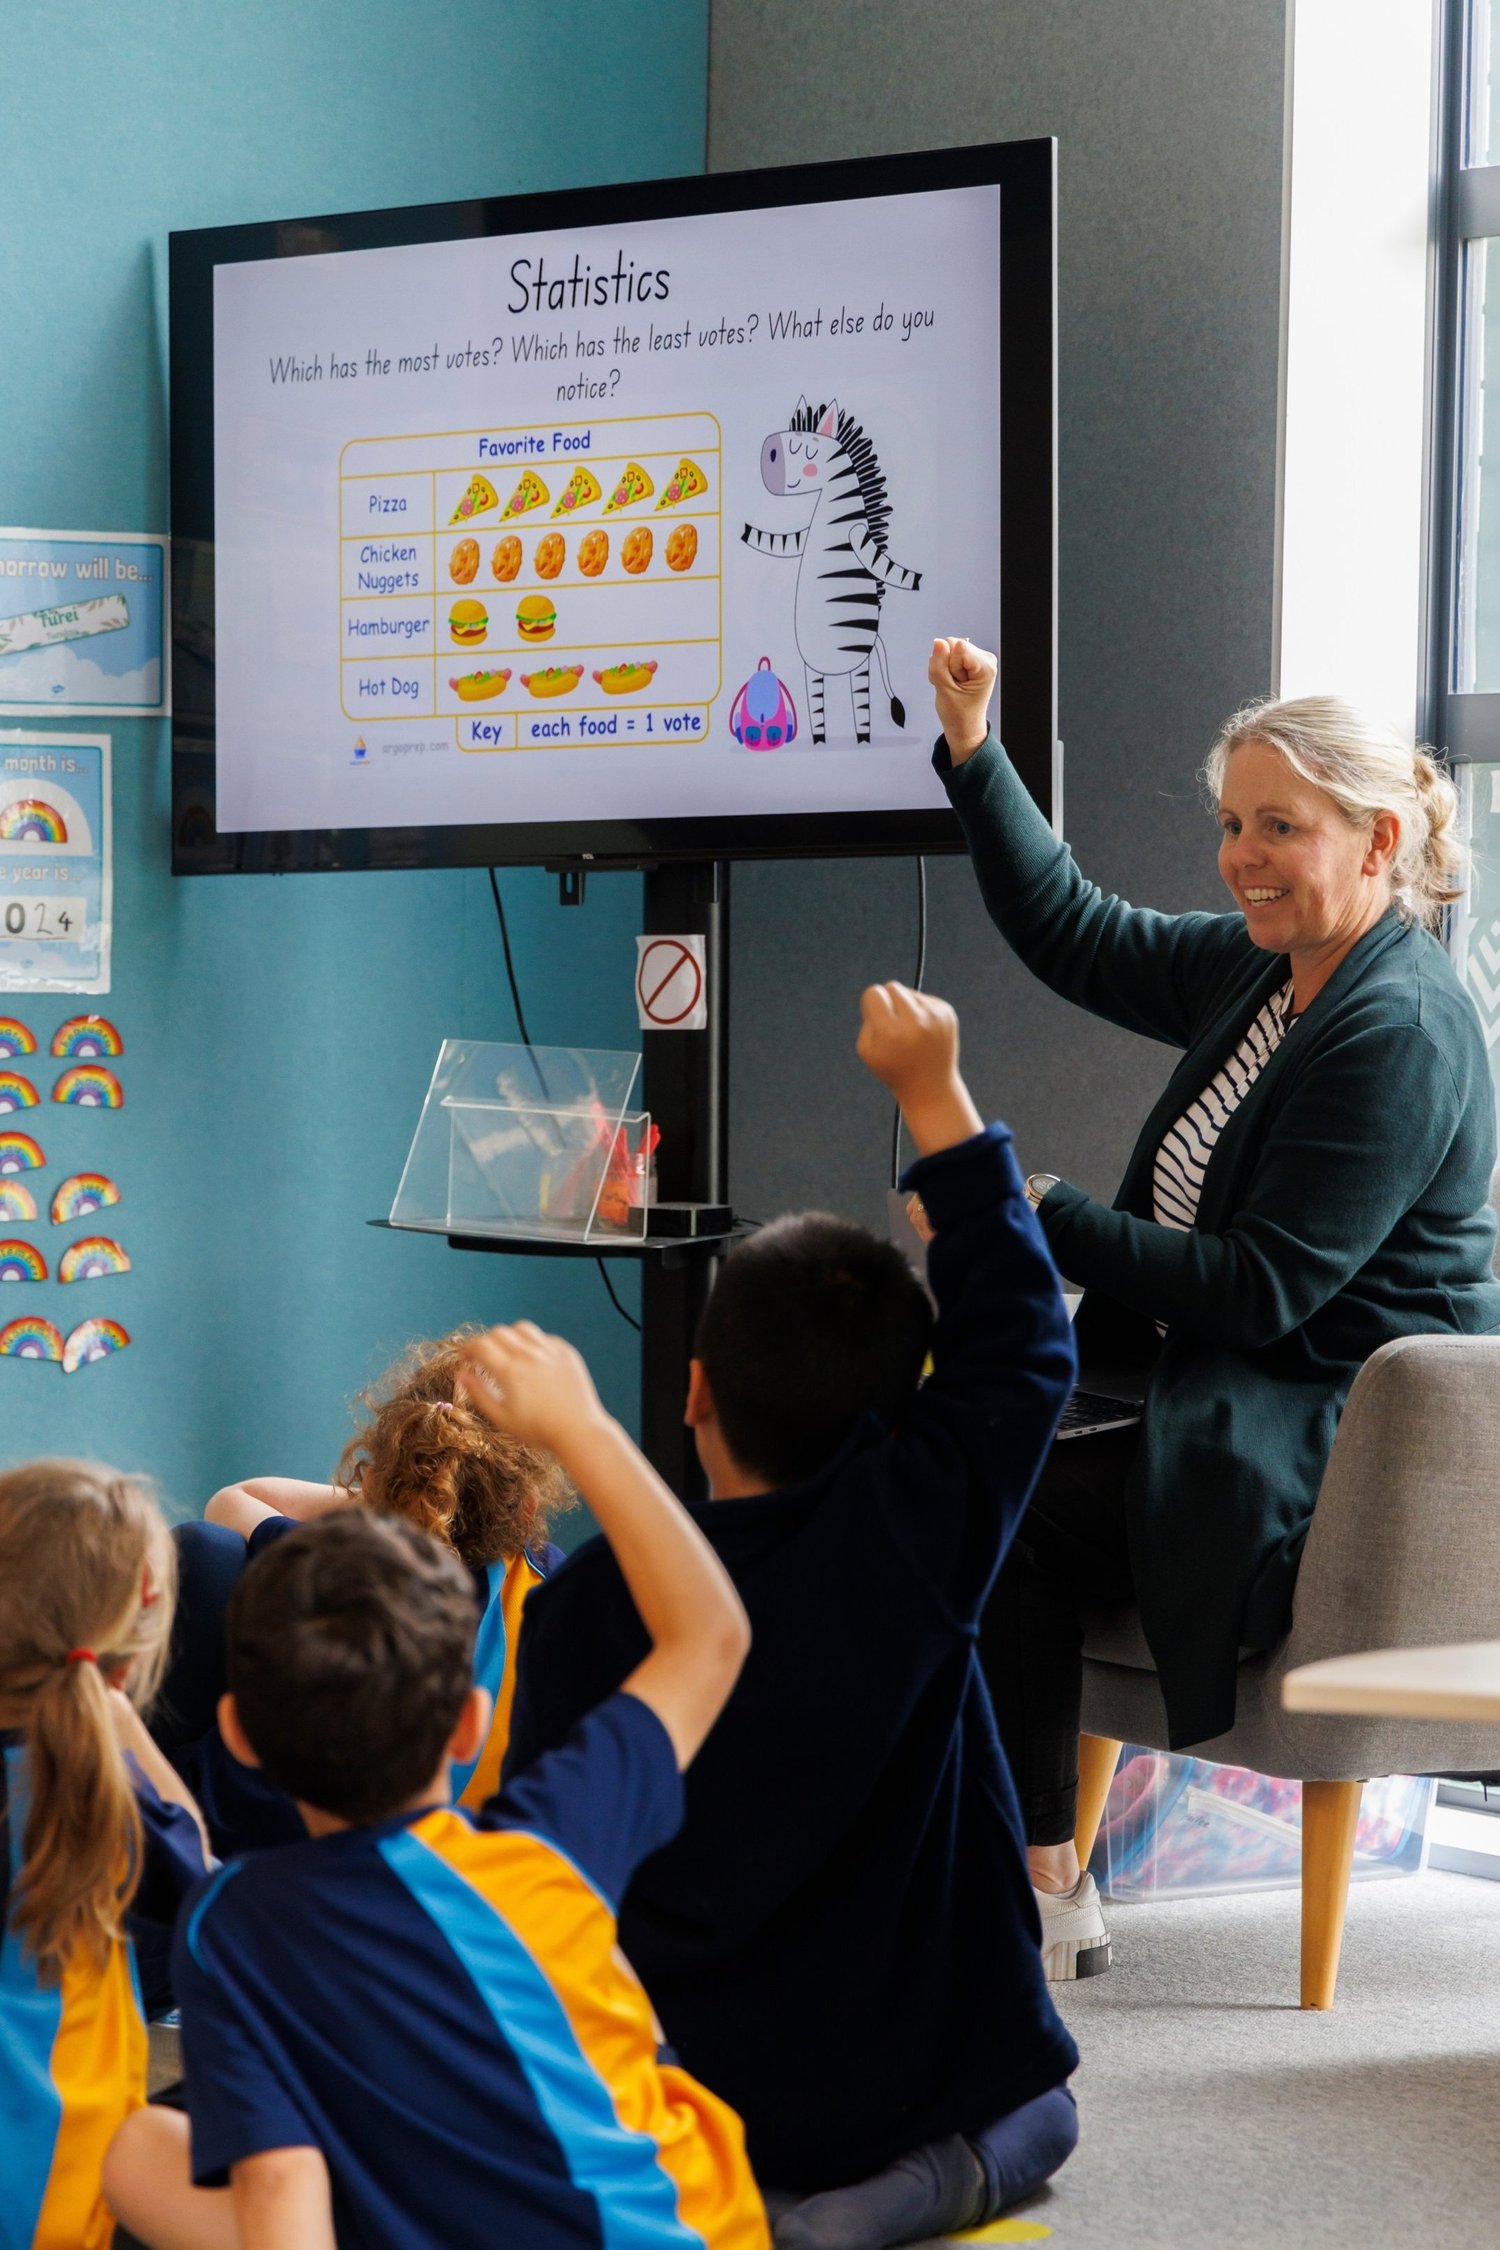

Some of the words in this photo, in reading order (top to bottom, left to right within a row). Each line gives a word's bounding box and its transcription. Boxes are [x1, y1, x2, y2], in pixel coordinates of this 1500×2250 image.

[507, 249, 671, 314] Statistics
[269, 354, 323, 384] Which
[330, 352, 358, 379] has
[364, 349, 391, 376] the
[398, 343, 440, 374] most
[446, 337, 503, 368] votes?
[511, 331, 568, 363] Which
[576, 330, 605, 357] has
[613, 326, 640, 354] the
[649, 320, 692, 352] least
[698, 313, 759, 346] votes?
[768, 308, 823, 341] What
[830, 306, 864, 335] else
[872, 302, 894, 332] do
[902, 309, 935, 342] you
[556, 368, 621, 402] notice?
[479, 436, 545, 458] Favorite
[552, 430, 591, 453] Food
[368, 495, 408, 513] Pizza
[360, 545, 417, 564] Chicken
[75, 557, 109, 579] will
[358, 571, 419, 595] Nuggets
[348, 616, 429, 637] Hamburger
[359, 678, 387, 697] Hot
[391, 677, 419, 699] Dog
[471, 720, 502, 744] Key
[531, 716, 571, 737] each
[579, 714, 618, 736] food
[646, 713, 653, 733] 1
[663, 712, 701, 732] vote
[5, 754, 57, 772] month
[13, 867, 49, 884] year
